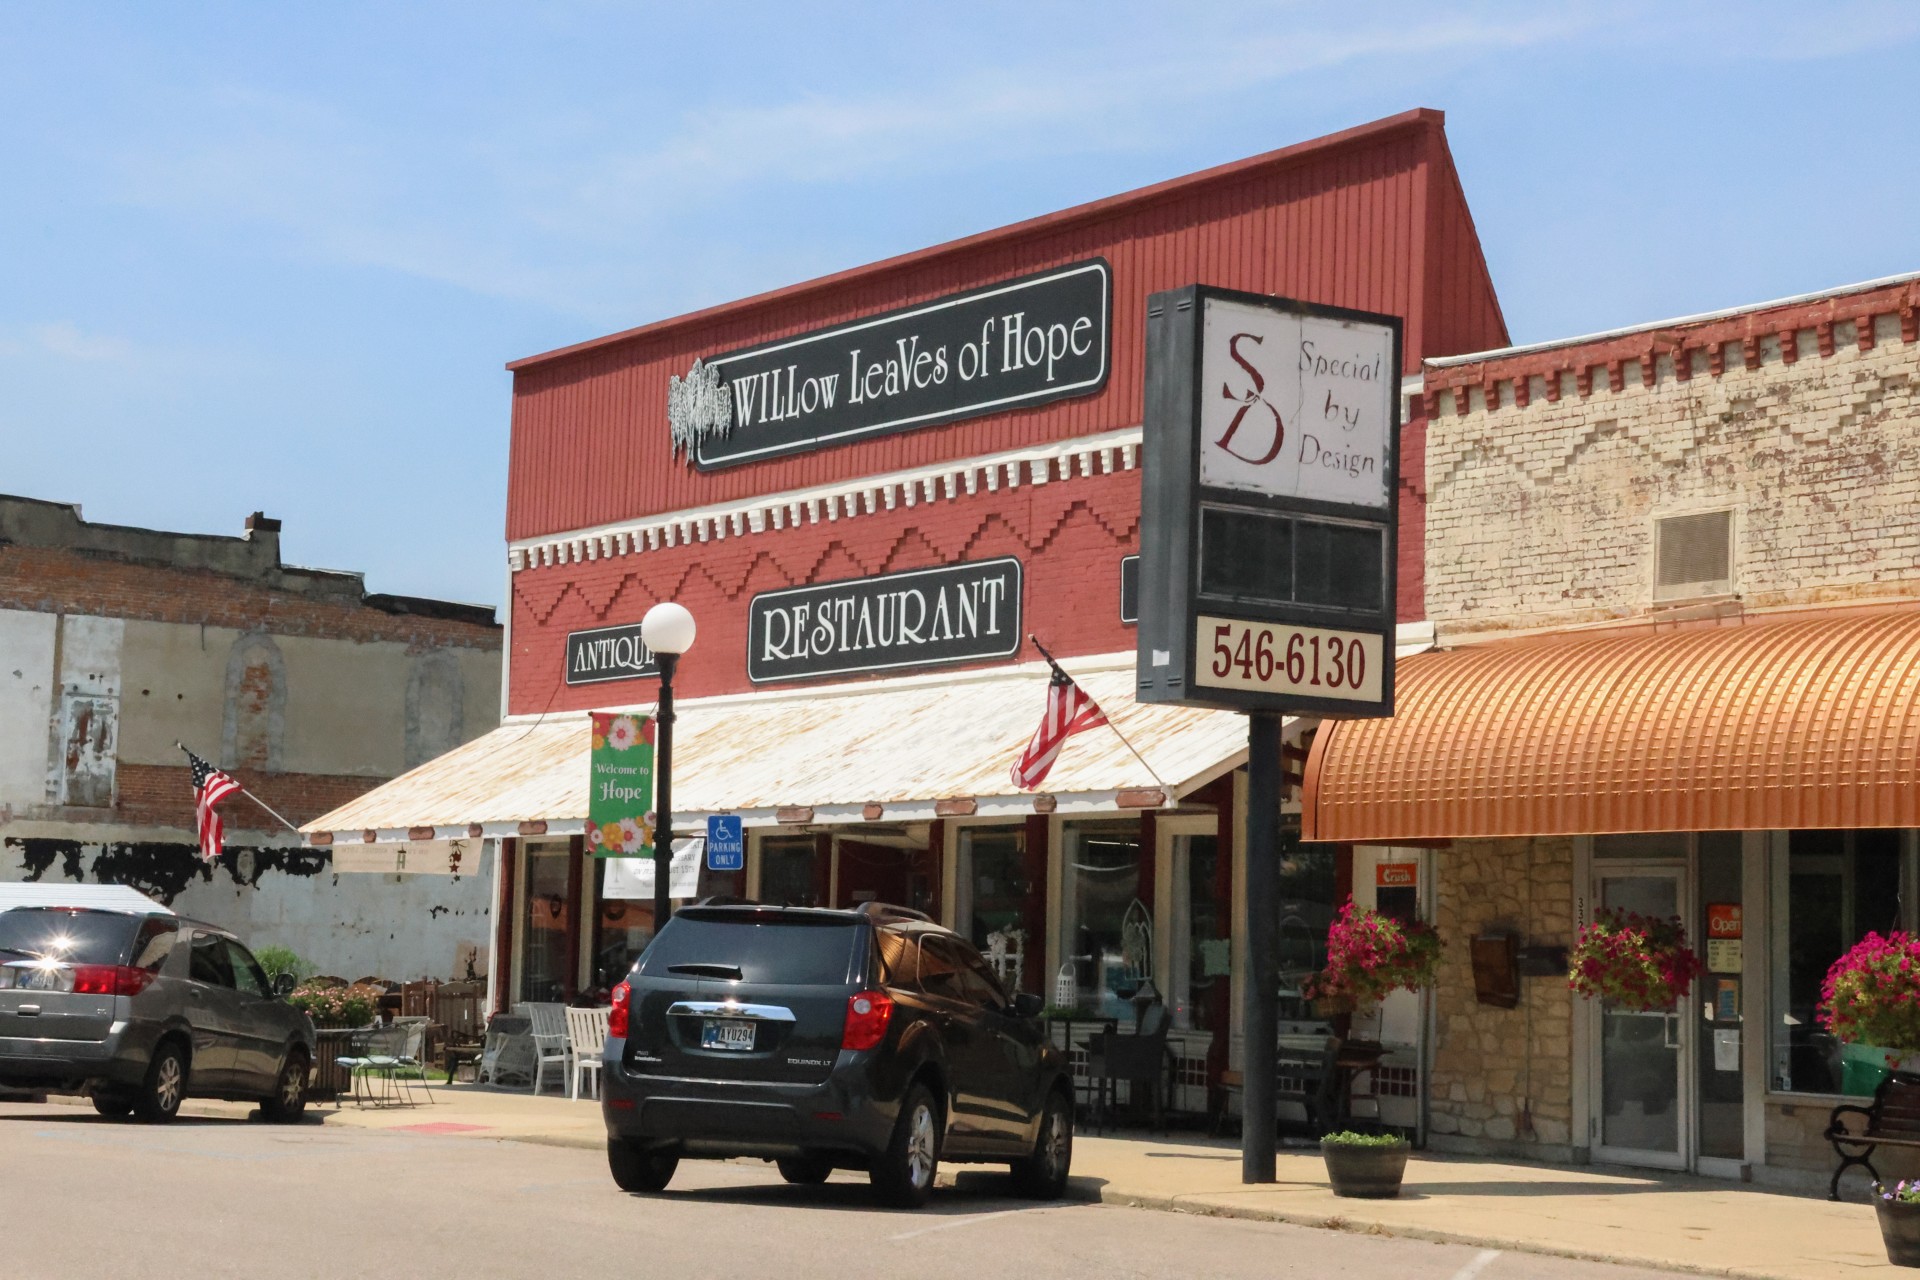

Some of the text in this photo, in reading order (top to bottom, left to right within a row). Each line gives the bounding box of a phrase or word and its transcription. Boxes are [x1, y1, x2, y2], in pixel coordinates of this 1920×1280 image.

[958, 317, 995, 382] of
[1001, 312, 1092, 382] Hope
[1299, 340, 1381, 382] Special
[1324, 389, 1360, 432] by
[1298, 434, 1375, 479] Design
[761, 574, 1006, 662] RESTAURANT
[1212, 624, 1366, 690] 546-6130
[594, 763, 649, 776] Welcome to
[599, 778, 642, 804] Hope
[709, 842, 741, 853] PARKING
[715, 854, 735, 865] ONLY
[1711, 916, 1741, 935] Open
[720, 1028, 753, 1042] AYU294
